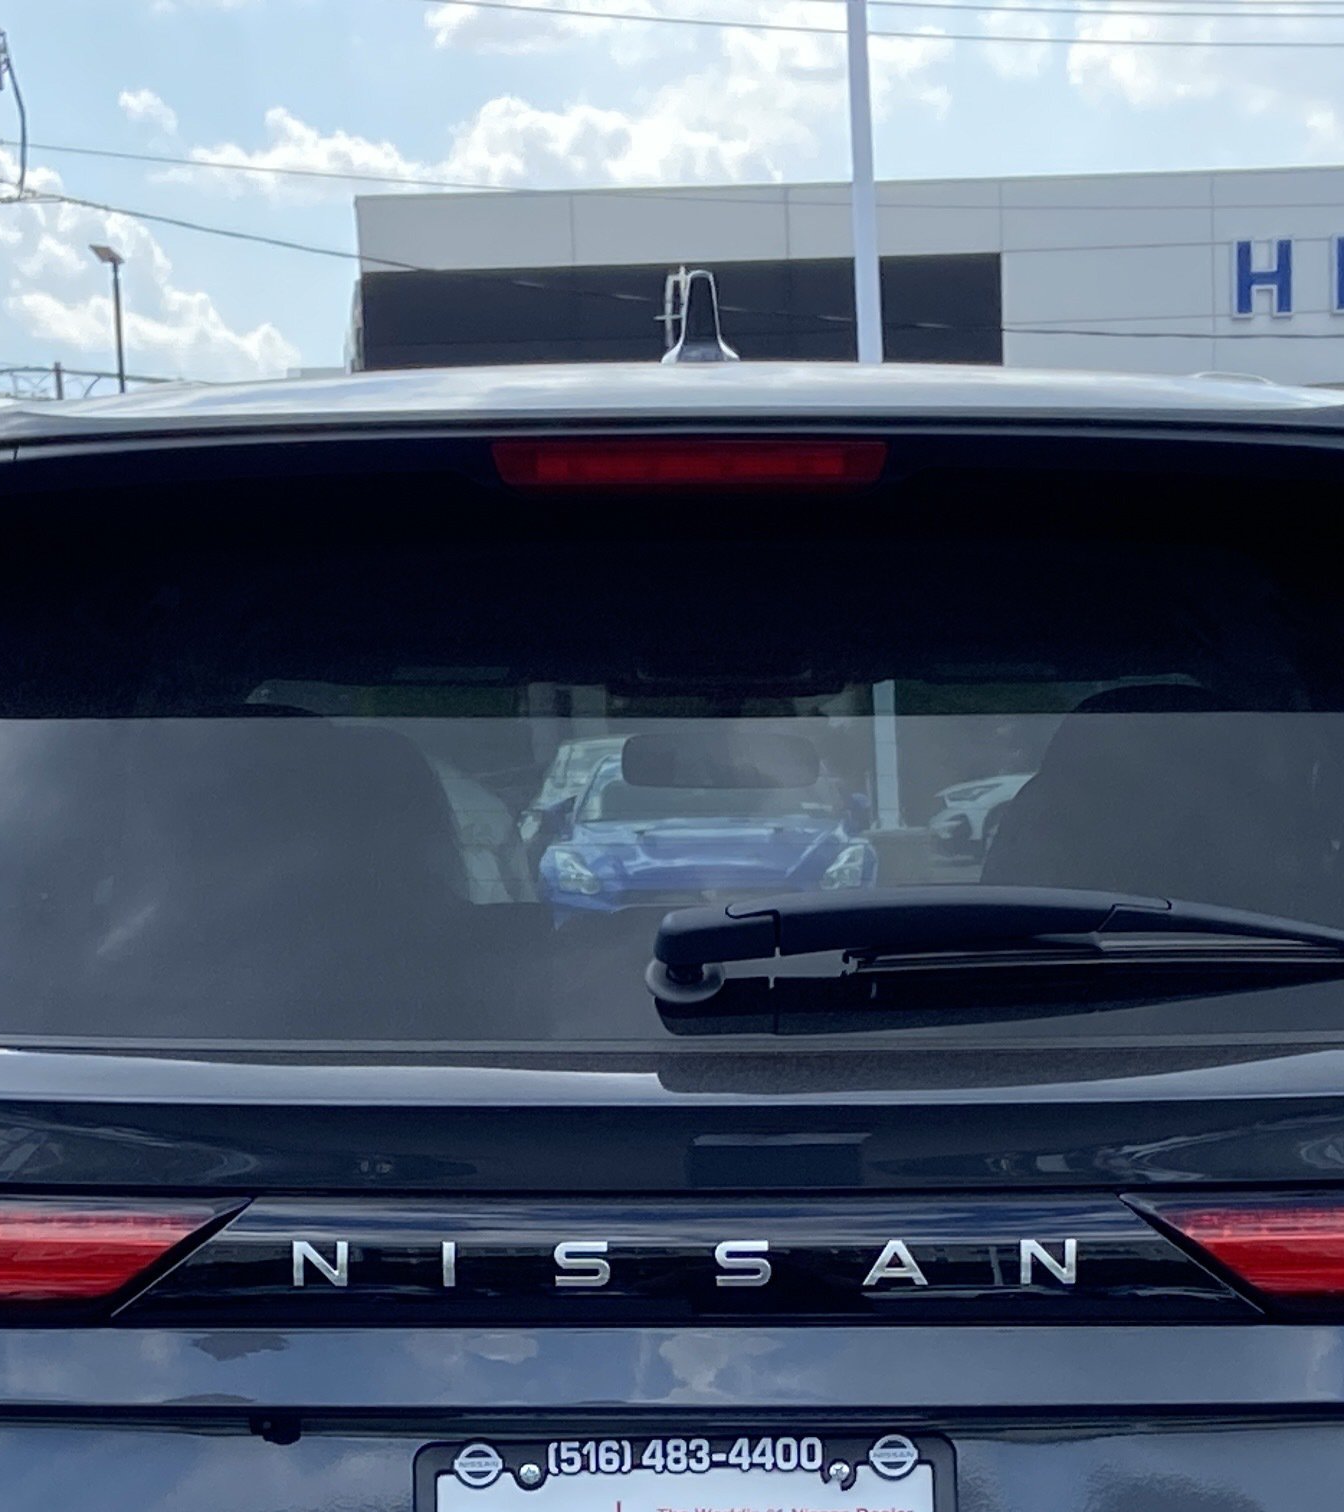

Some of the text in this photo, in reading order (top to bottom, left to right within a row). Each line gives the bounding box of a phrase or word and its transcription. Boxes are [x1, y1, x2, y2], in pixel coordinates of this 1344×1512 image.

[292, 1239, 1077, 1287] NISSAN
[548, 1438, 823, 1475] (516) 483-4400
